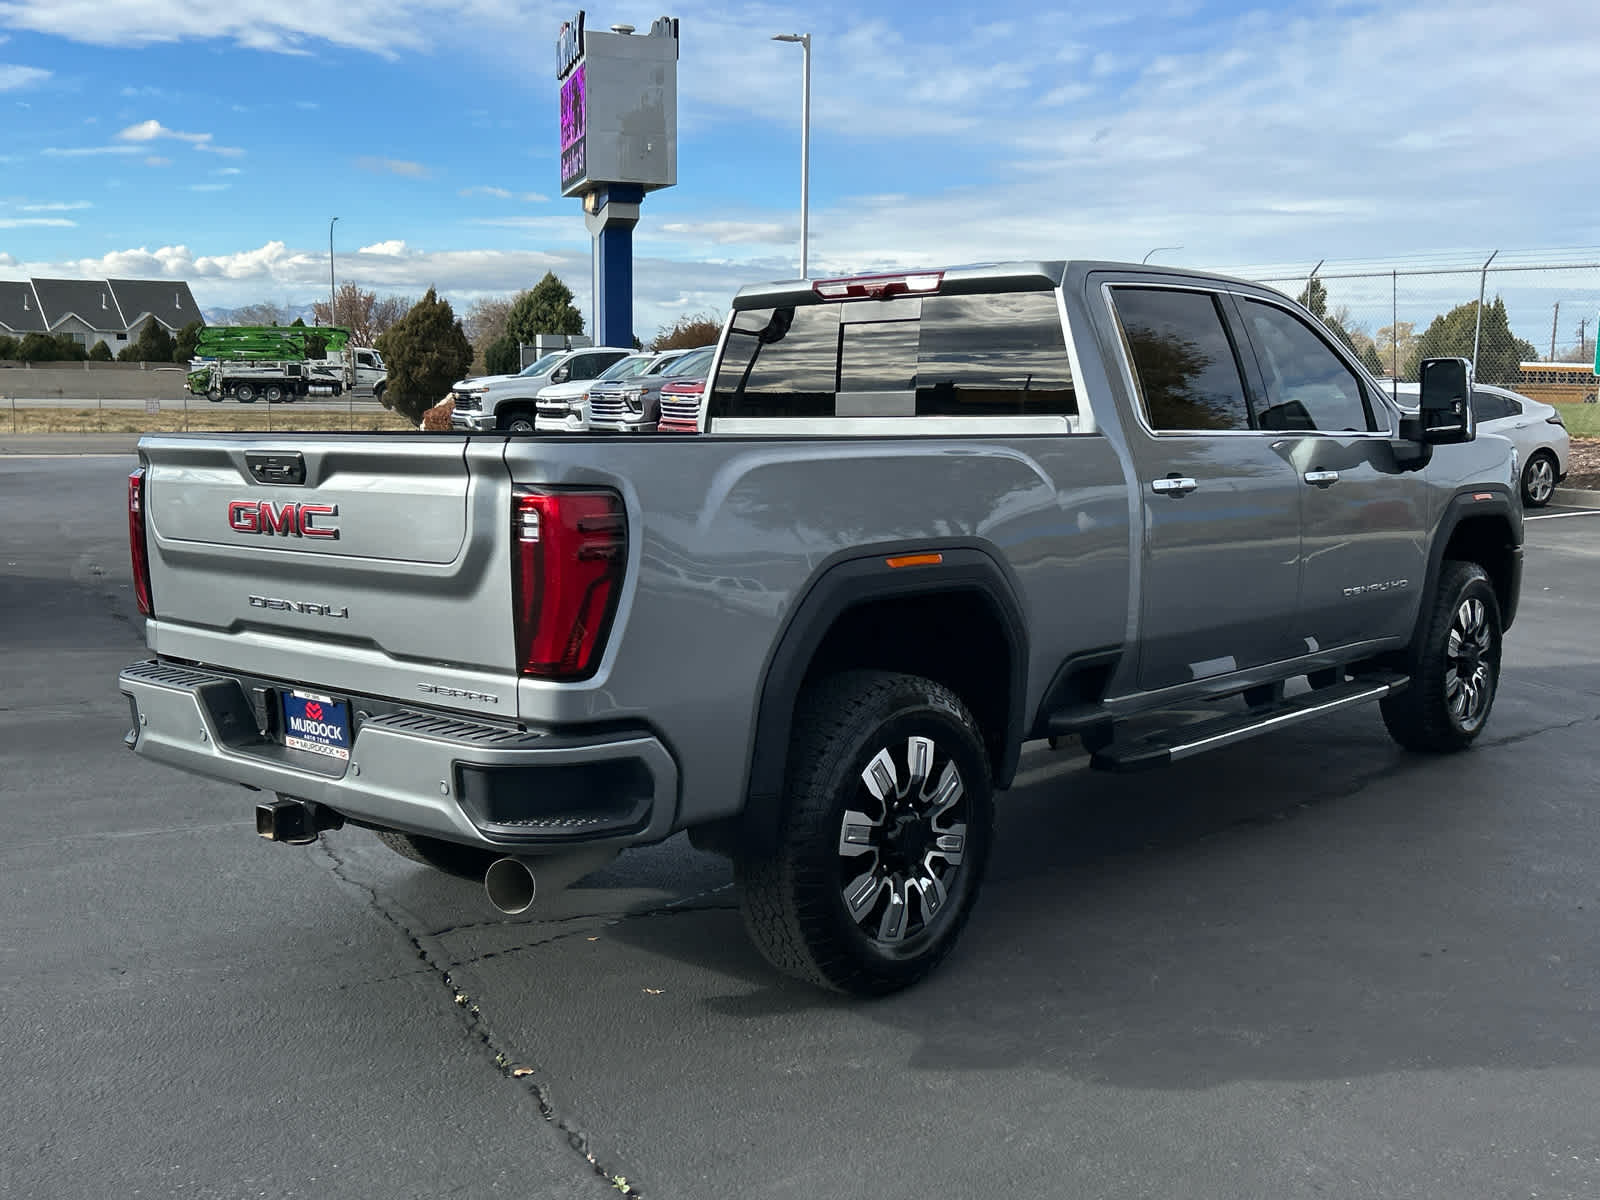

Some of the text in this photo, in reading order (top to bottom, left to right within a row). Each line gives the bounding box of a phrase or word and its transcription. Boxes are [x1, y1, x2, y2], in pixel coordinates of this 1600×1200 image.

[228, 500, 340, 540] GMC
[248, 594, 349, 619] DENALI
[416, 682, 498, 703] SIERRA
[290, 716, 342, 741] MURDOCK
